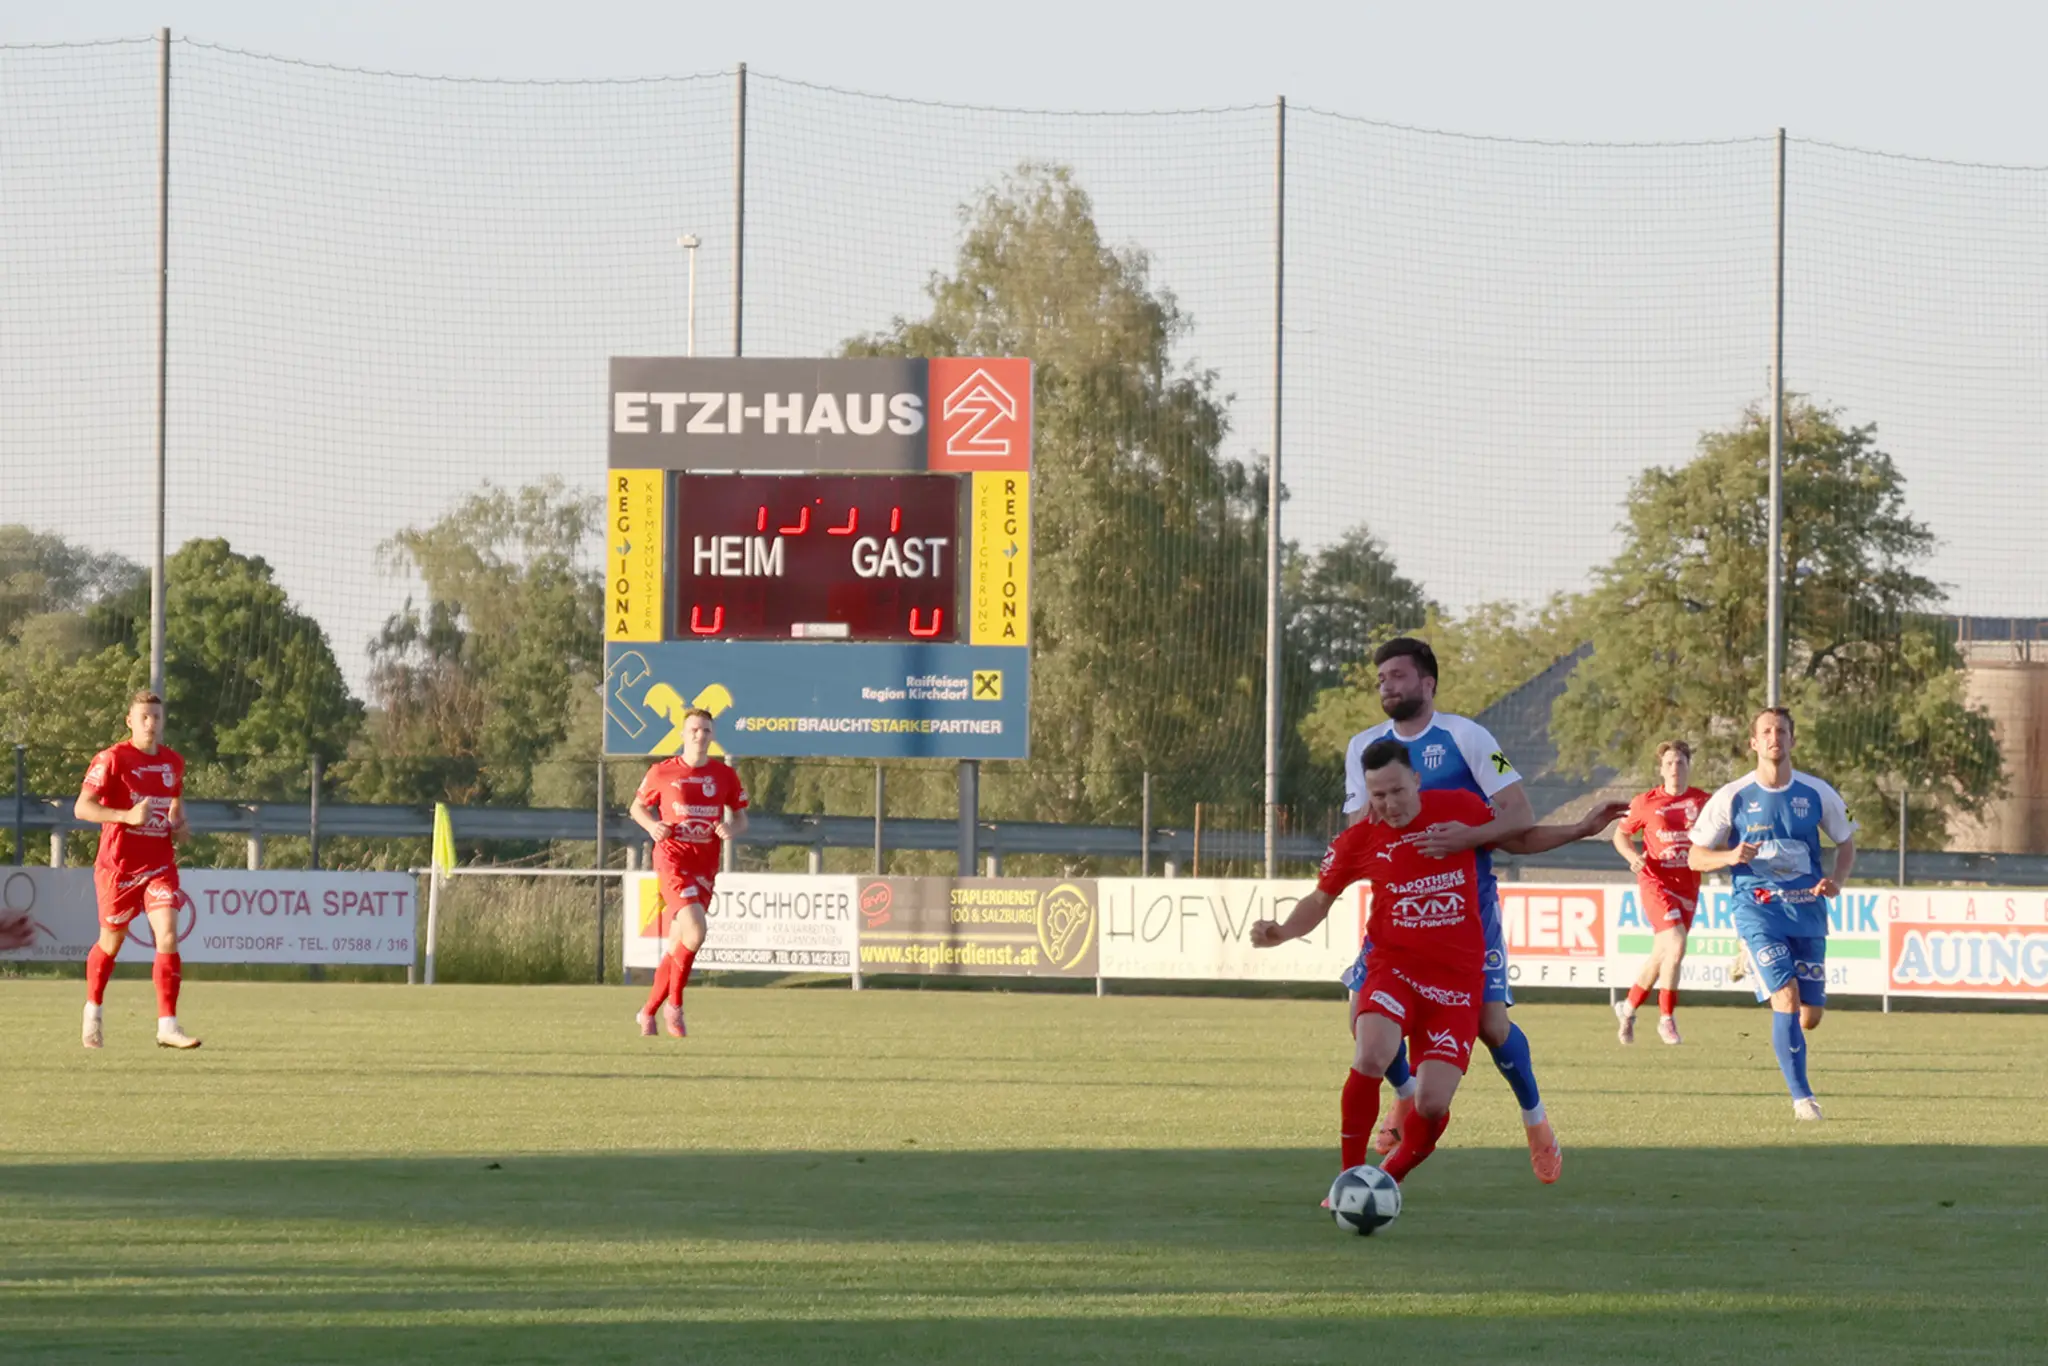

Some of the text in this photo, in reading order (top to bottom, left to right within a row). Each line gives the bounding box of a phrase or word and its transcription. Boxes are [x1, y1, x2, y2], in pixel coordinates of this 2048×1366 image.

[613, 391, 925, 436] ETZI-HAUS
[693, 535, 785, 577] HEIM
[851, 536, 949, 579] GAST
[861, 686, 968, 702] Region Kirchdorf
[906, 675, 969, 688] Raiffeisen
[734, 717, 1002, 735] #SPORTBRAUCHTSTARKEPARTNER
[204, 889, 409, 917] TOYOTA SPATT
[708, 891, 850, 921] OTSCHHOFER
[950, 889, 1037, 905] STAPLERDIENST
[1396, 895, 1458, 916] TVM
[1499, 896, 1598, 948] MER
[204, 936, 284, 949] VOITSDORF
[299, 937, 328, 951] TEL.
[333, 938, 371, 951] 07588
[387, 939, 409, 951] 316
[860, 942, 1038, 967] www.staplerdienst.at
